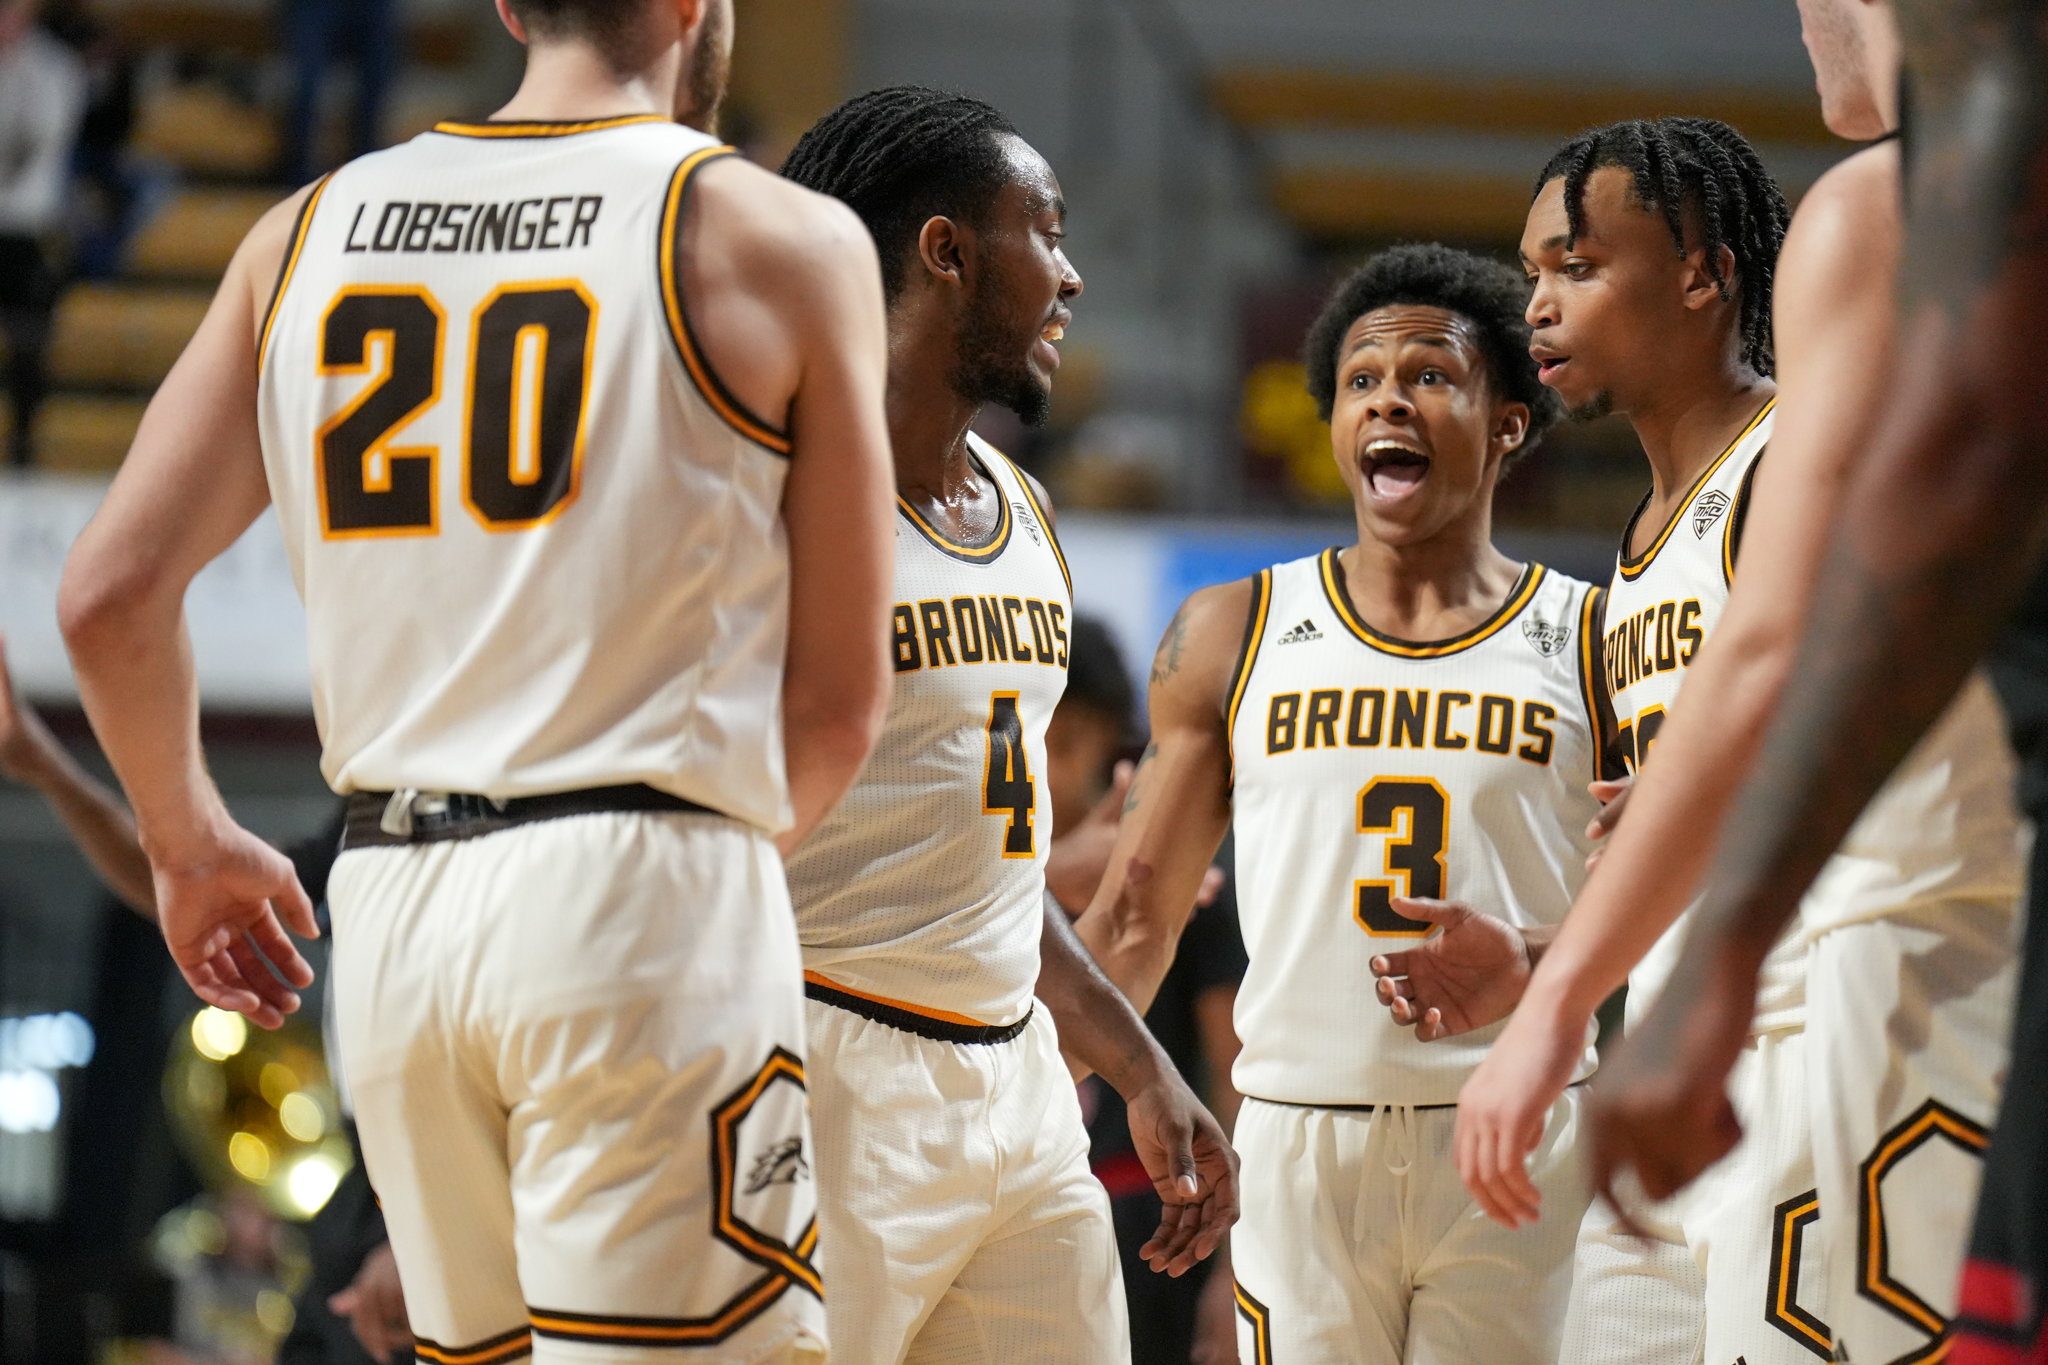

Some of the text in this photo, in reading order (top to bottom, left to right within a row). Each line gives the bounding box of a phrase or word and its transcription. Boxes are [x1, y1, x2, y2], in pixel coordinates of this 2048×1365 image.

[344, 195, 603, 254] LOBSINGER
[314, 277, 600, 542] 20
[891, 595, 1068, 674] BRONCOS
[1277, 632, 1323, 645] adidas
[1603, 598, 1704, 700] RONCOS
[1266, 687, 1558, 768] BRONCOS
[981, 690, 1036, 859] 4
[1353, 775, 1451, 939] 3
